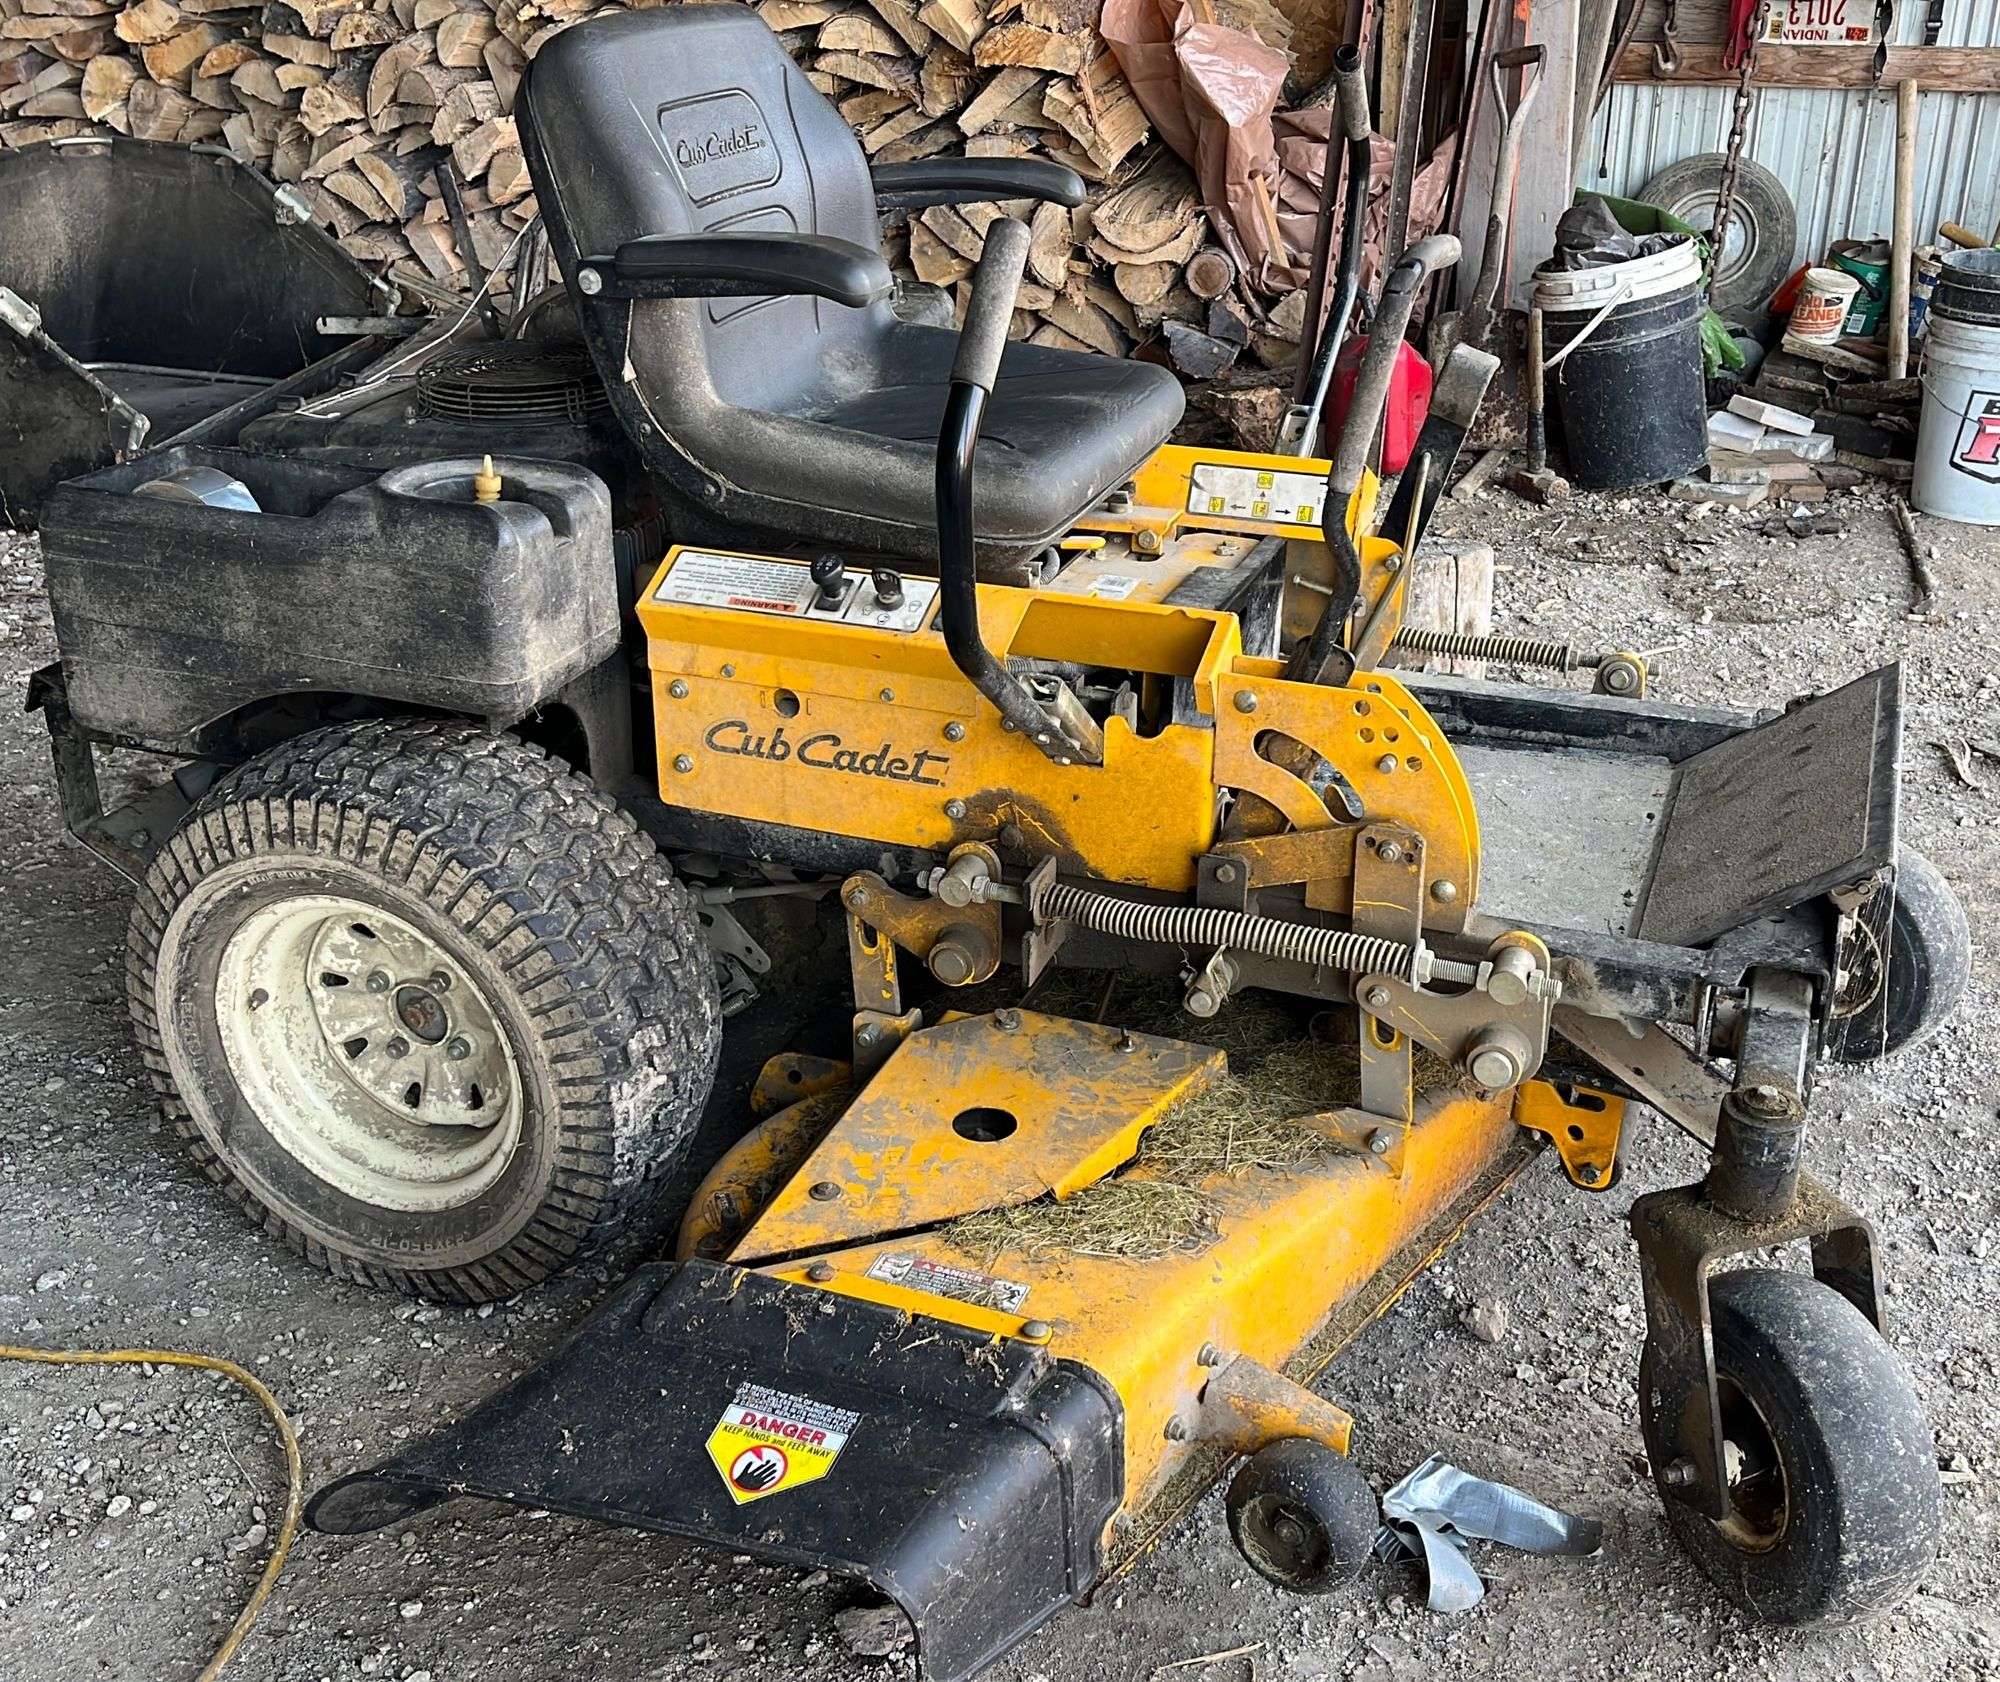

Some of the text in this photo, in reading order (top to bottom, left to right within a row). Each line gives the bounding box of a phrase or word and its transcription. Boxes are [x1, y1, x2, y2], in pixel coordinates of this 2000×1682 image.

[1784, 29, 1829, 41] INDIAN
[735, 598, 778, 610] WARNING
[705, 720, 949, 786] Cub Cadet
[934, 1265, 983, 1281] DANGER
[722, 1423, 830, 1457] KEEP HANDS and FEET AWAY
[739, 1411, 827, 1445] DANGER
